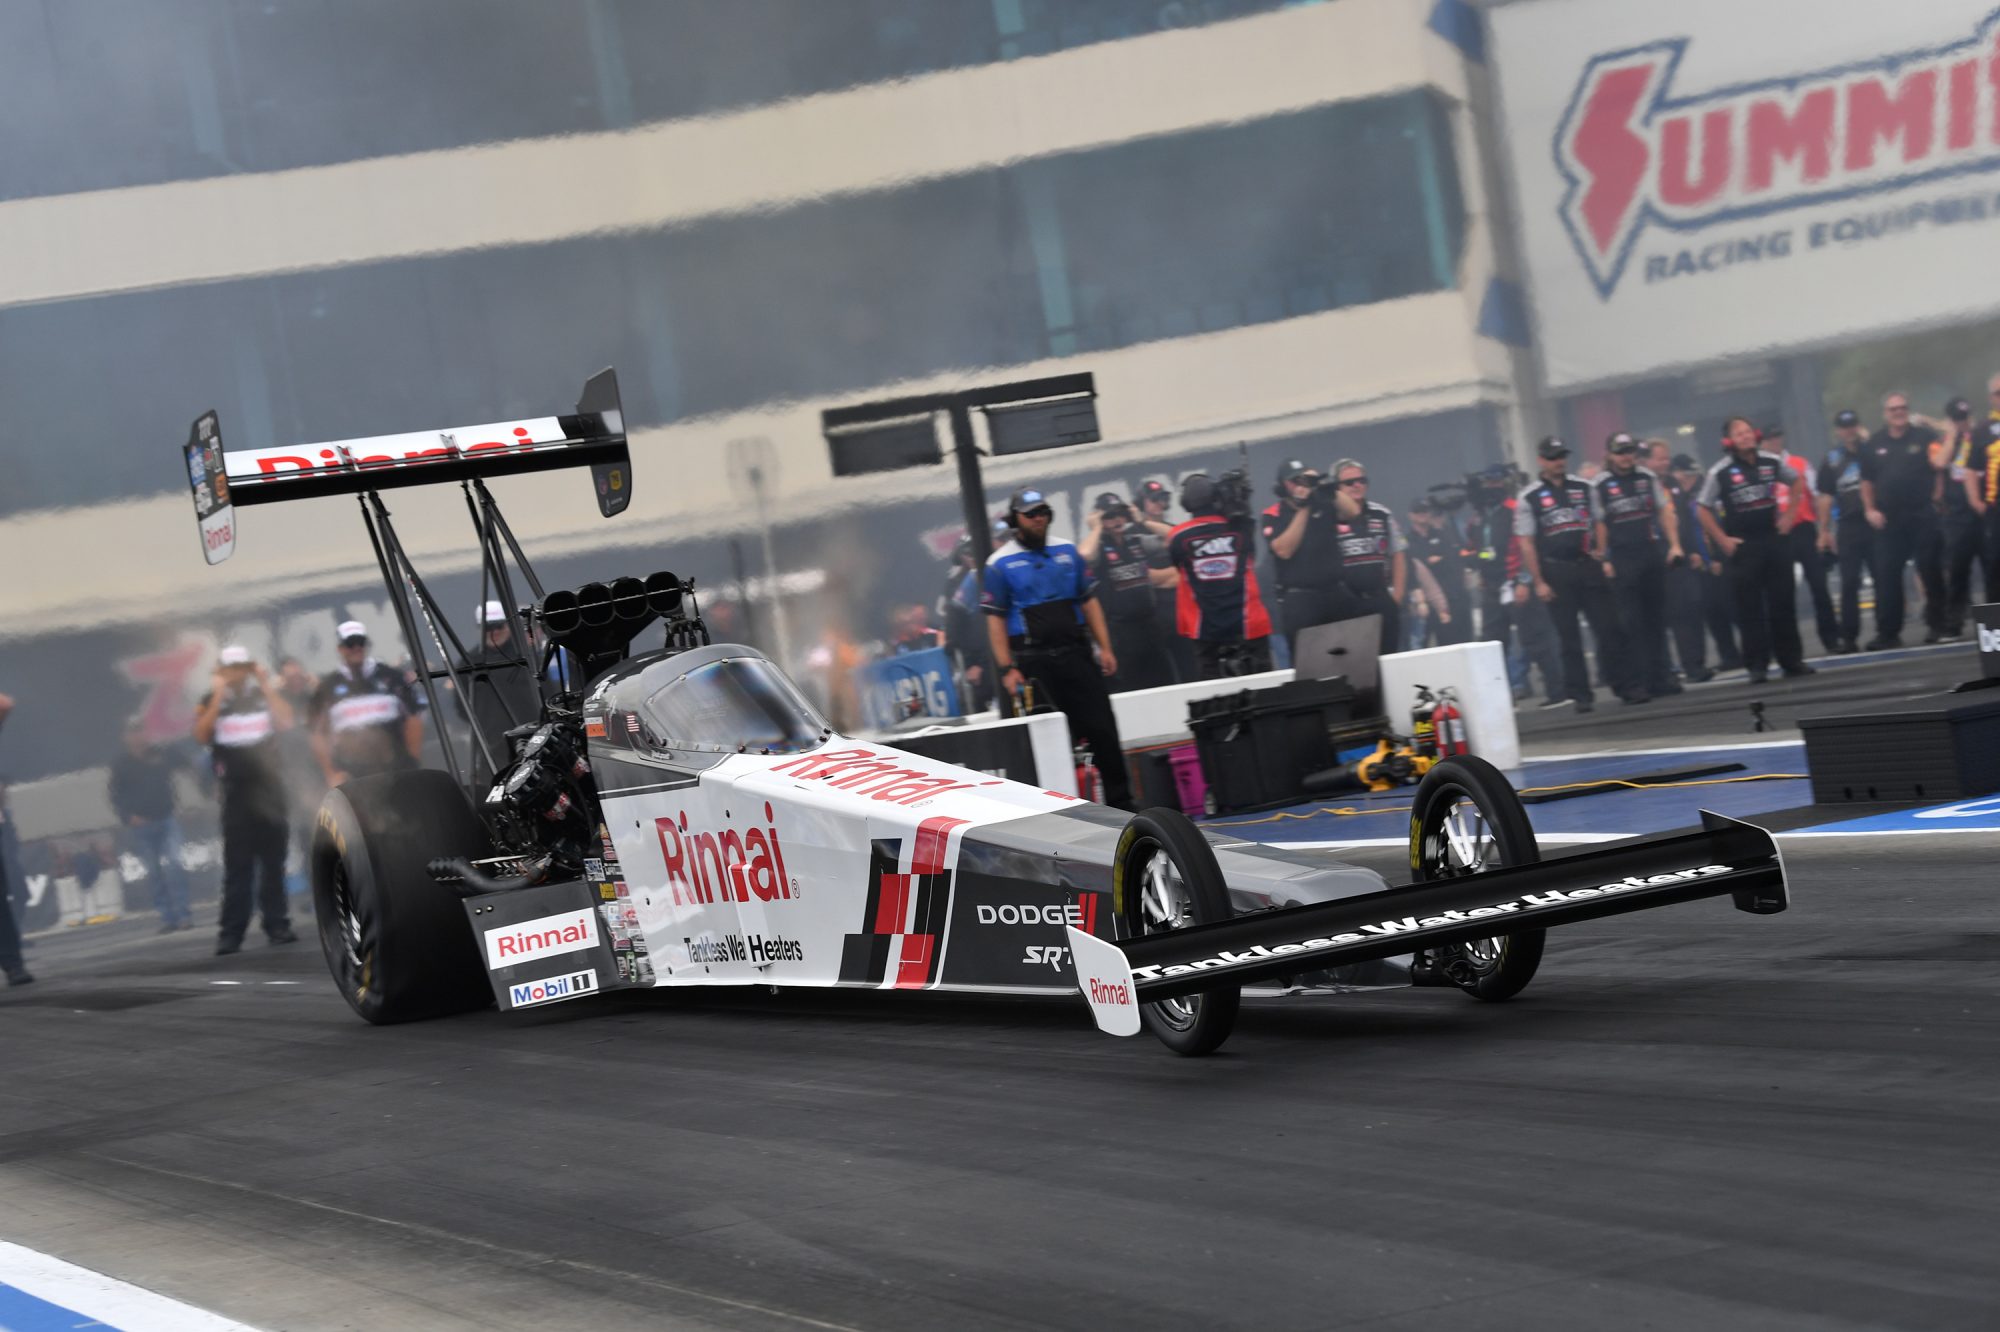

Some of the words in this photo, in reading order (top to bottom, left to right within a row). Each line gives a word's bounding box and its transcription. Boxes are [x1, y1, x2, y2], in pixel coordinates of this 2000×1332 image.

[1573, 32, 2000, 256] SUMMI
[1645, 230, 1791, 284] RACING
[1808, 192, 2000, 249] EQUIPME
[769, 749, 1004, 806] Rinnai
[655, 800, 791, 906] Rinnai
[498, 918, 588, 958] Rinnai
[976, 904, 1084, 925] DODGE
[1131, 931, 1368, 981] Tankless
[1360, 902, 1521, 937] Water
[1521, 864, 1734, 908] Heaters
[683, 936, 729, 963] Tankless
[747, 934, 803, 962] Heaters
[514, 978, 569, 1004] Mobil
[574, 975, 587, 990] 1
[1089, 977, 1130, 1005] Rinnai
